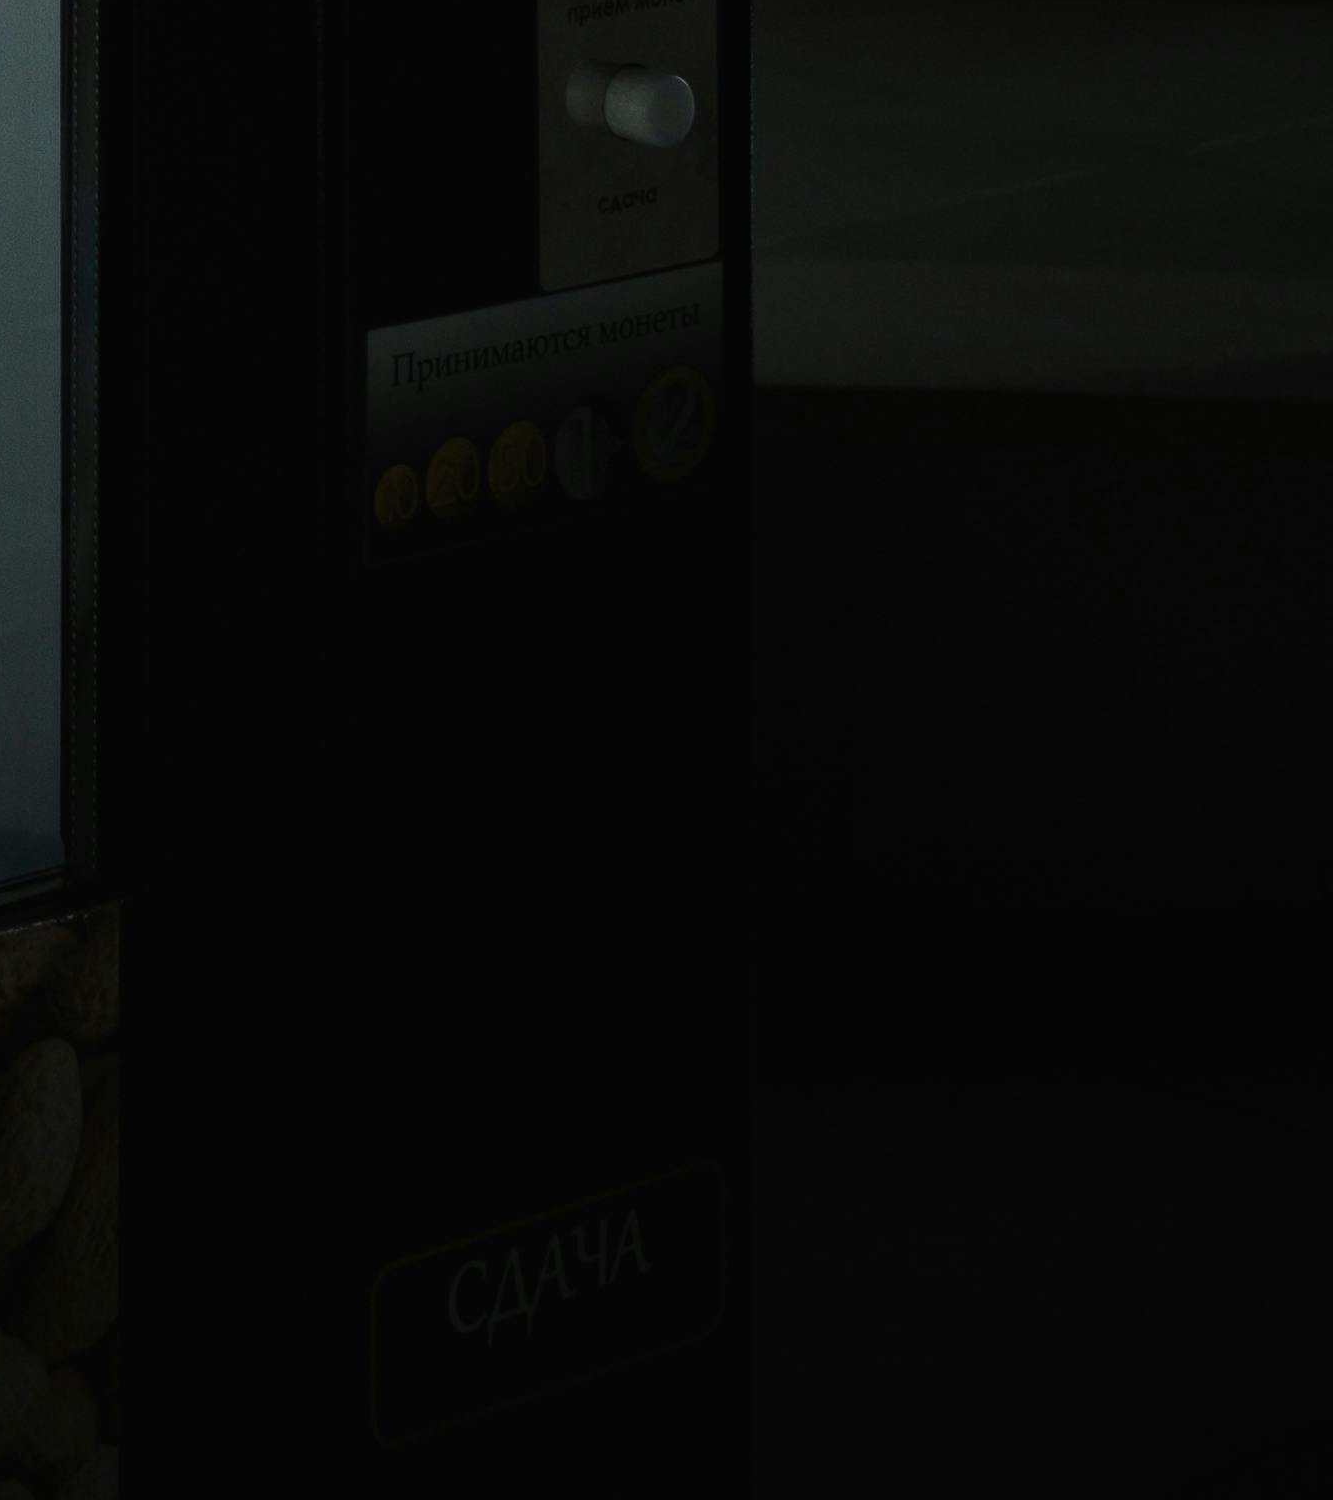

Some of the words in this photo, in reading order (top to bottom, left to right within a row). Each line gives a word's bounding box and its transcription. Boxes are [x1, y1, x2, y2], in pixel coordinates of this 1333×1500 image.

[596, 185, 659, 215] сдача
[390, 324, 592, 393] Принимаются
[597, 300, 701, 348] монеты
[446, 1207, 653, 1348] СДАЧА
